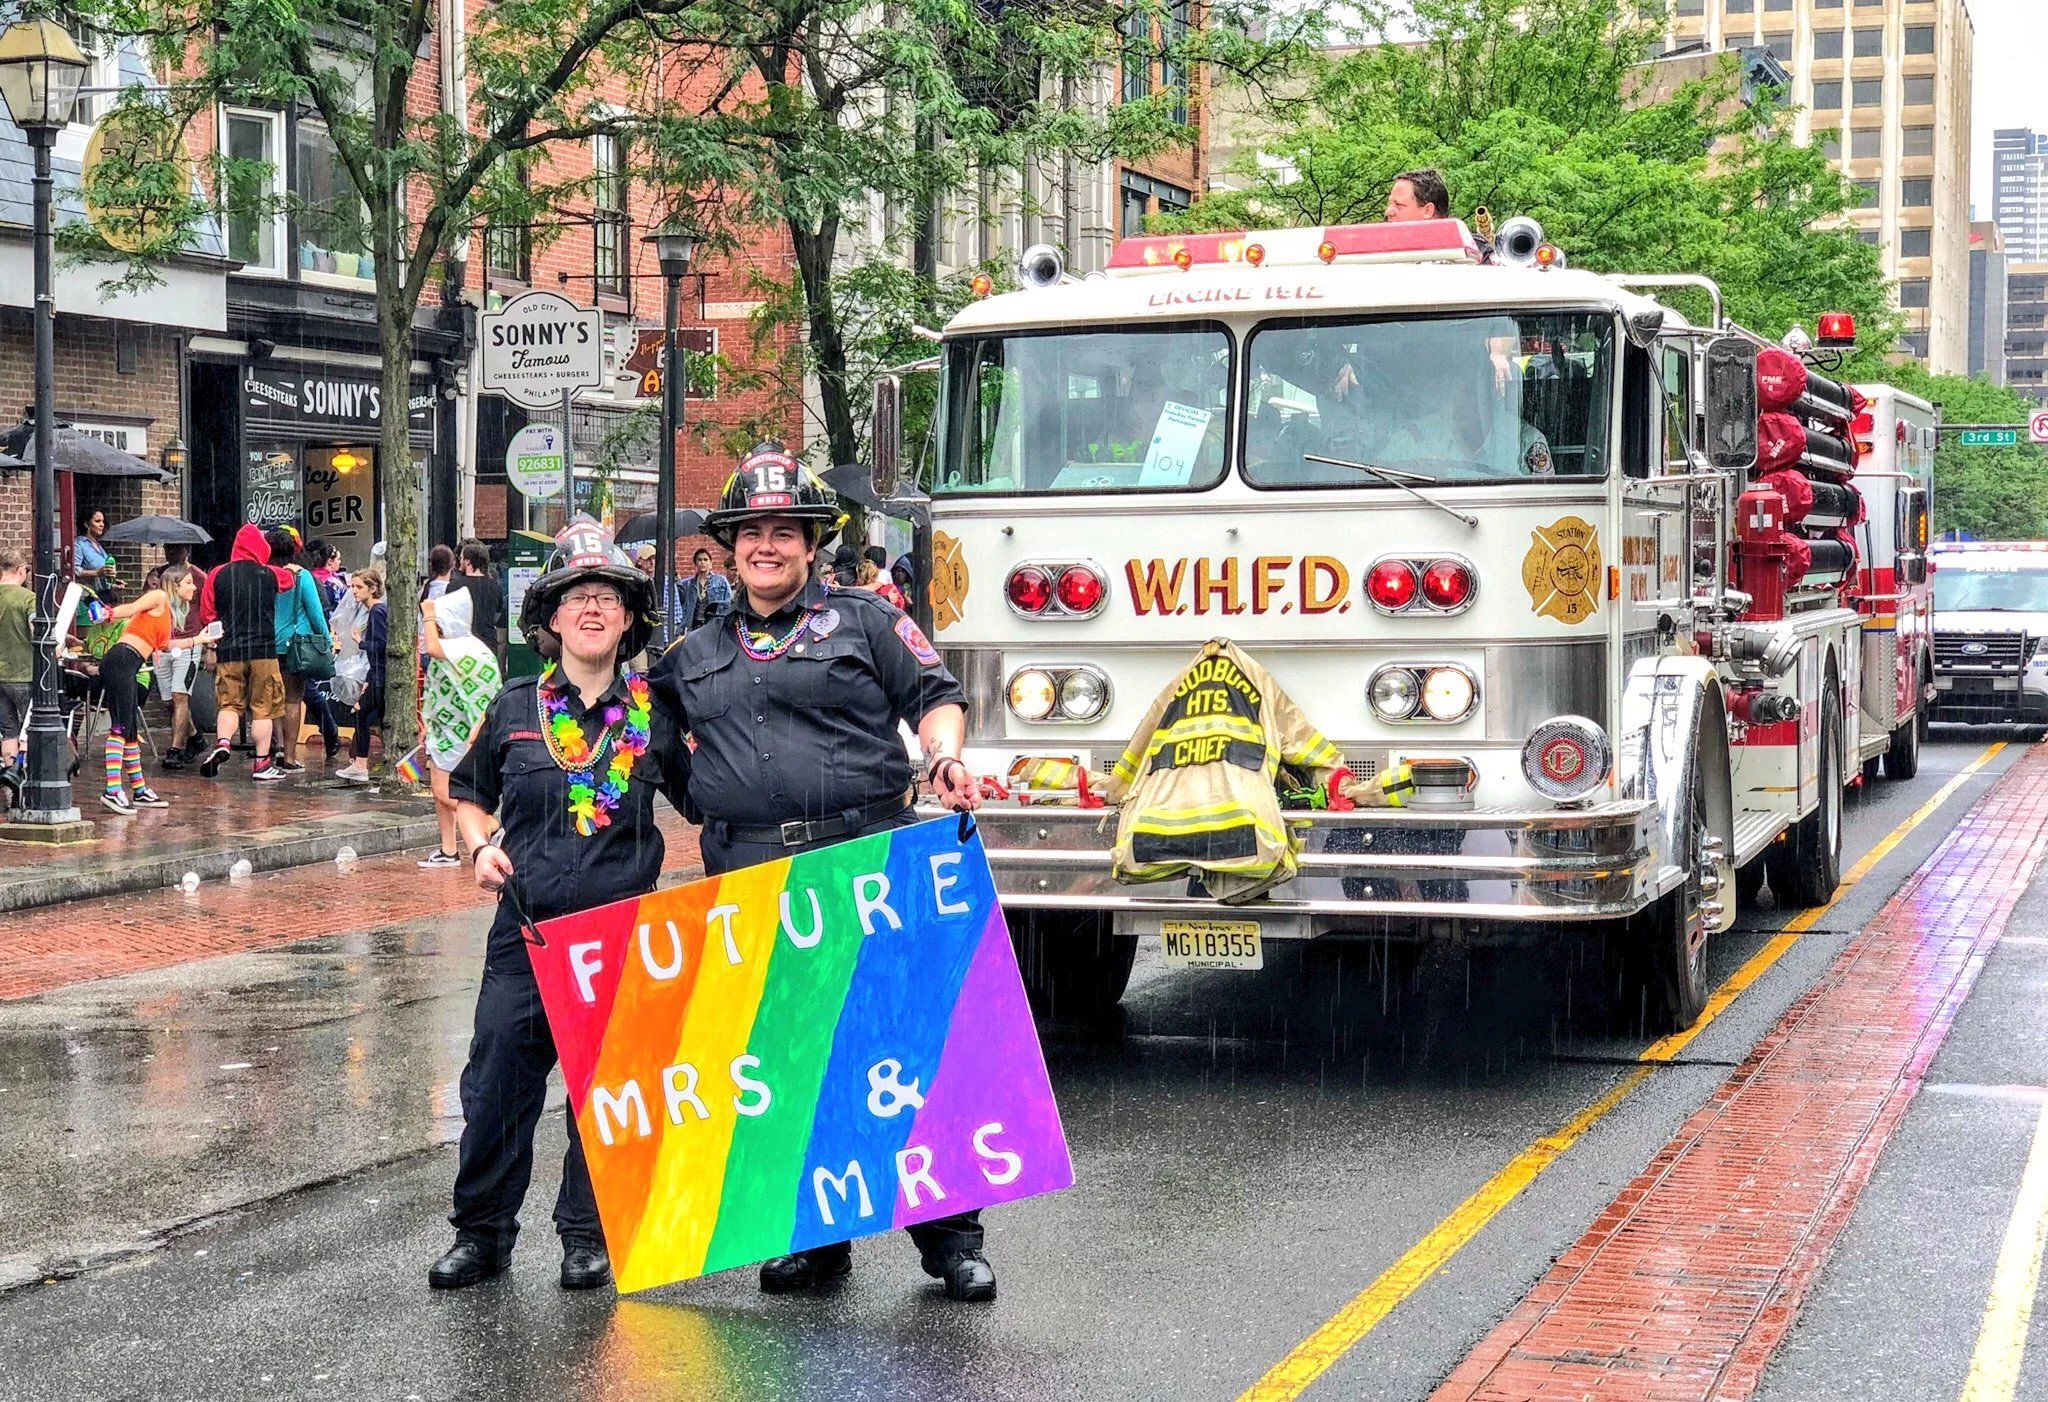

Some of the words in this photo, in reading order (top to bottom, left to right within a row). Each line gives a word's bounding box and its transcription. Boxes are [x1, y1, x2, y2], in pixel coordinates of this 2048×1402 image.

[523, 304, 538, 313] OLD
[541, 304, 559, 312] CITY
[492, 321, 589, 347] SONNY'S
[511, 349, 570, 369] Famous
[493, 371, 548, 379] CHEESESTEAKS
[302, 379, 381, 419] SONNY'S
[1968, 433, 1989, 442] 3rd
[1996, 432, 2009, 442] St
[249, 451, 263, 461] YOU
[519, 456, 561, 471] 926831
[1152, 450, 1185, 476] 104
[280, 480, 295, 490] OUR
[306, 466, 339, 492] icy
[754, 466, 786, 492] 15
[247, 490, 295, 526] Meat
[308, 494, 365, 528] GER
[570, 533, 603, 555] 15
[1556, 527, 1586, 541] STATION
[1567, 603, 1577, 614] 15
[1186, 688, 1233, 715] HTS.
[1174, 736, 1232, 766] CHIEF
[569, 852, 970, 1003] FUTURE
[1166, 933, 1256, 957] MG18355
[591, 1053, 772, 1146] MRS
[866, 1058, 926, 1119] &
[812, 1121, 1022, 1226] MRS
